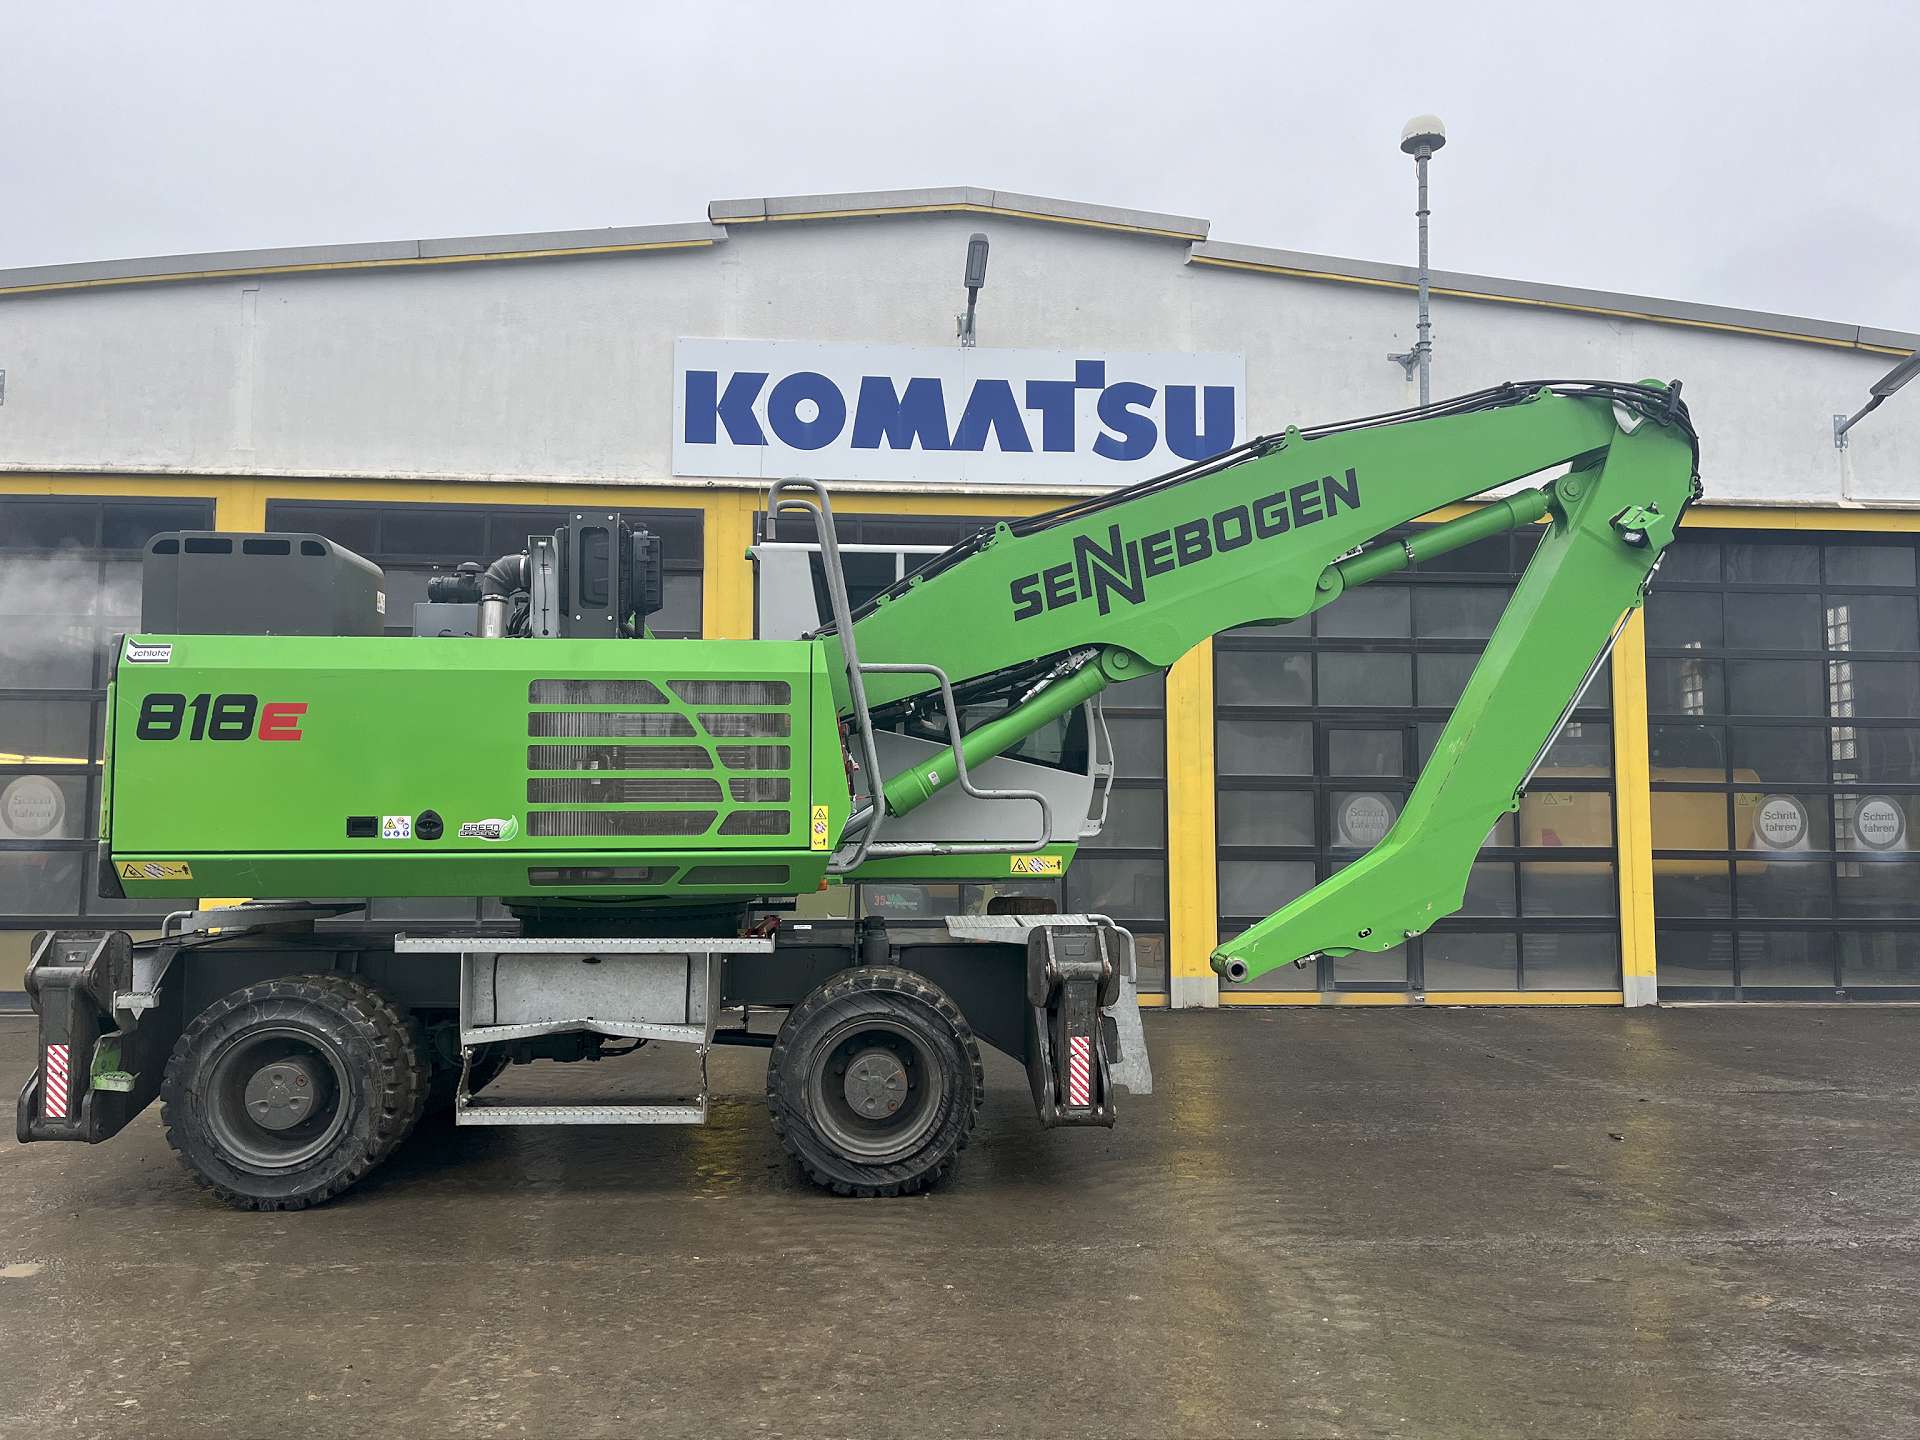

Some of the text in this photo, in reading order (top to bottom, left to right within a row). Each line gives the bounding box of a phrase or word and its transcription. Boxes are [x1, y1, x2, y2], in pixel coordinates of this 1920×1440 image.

[685, 359, 1235, 462] KOMATSU
[1010, 468, 1361, 622] SENNEBOGEN
[136, 693, 308, 741] 818E
[1764, 811, 1798, 820] Schritt
[1863, 812, 1896, 821] Schritt
[1765, 822, 1797, 832] fahren
[1864, 823, 1895, 833] fahren
